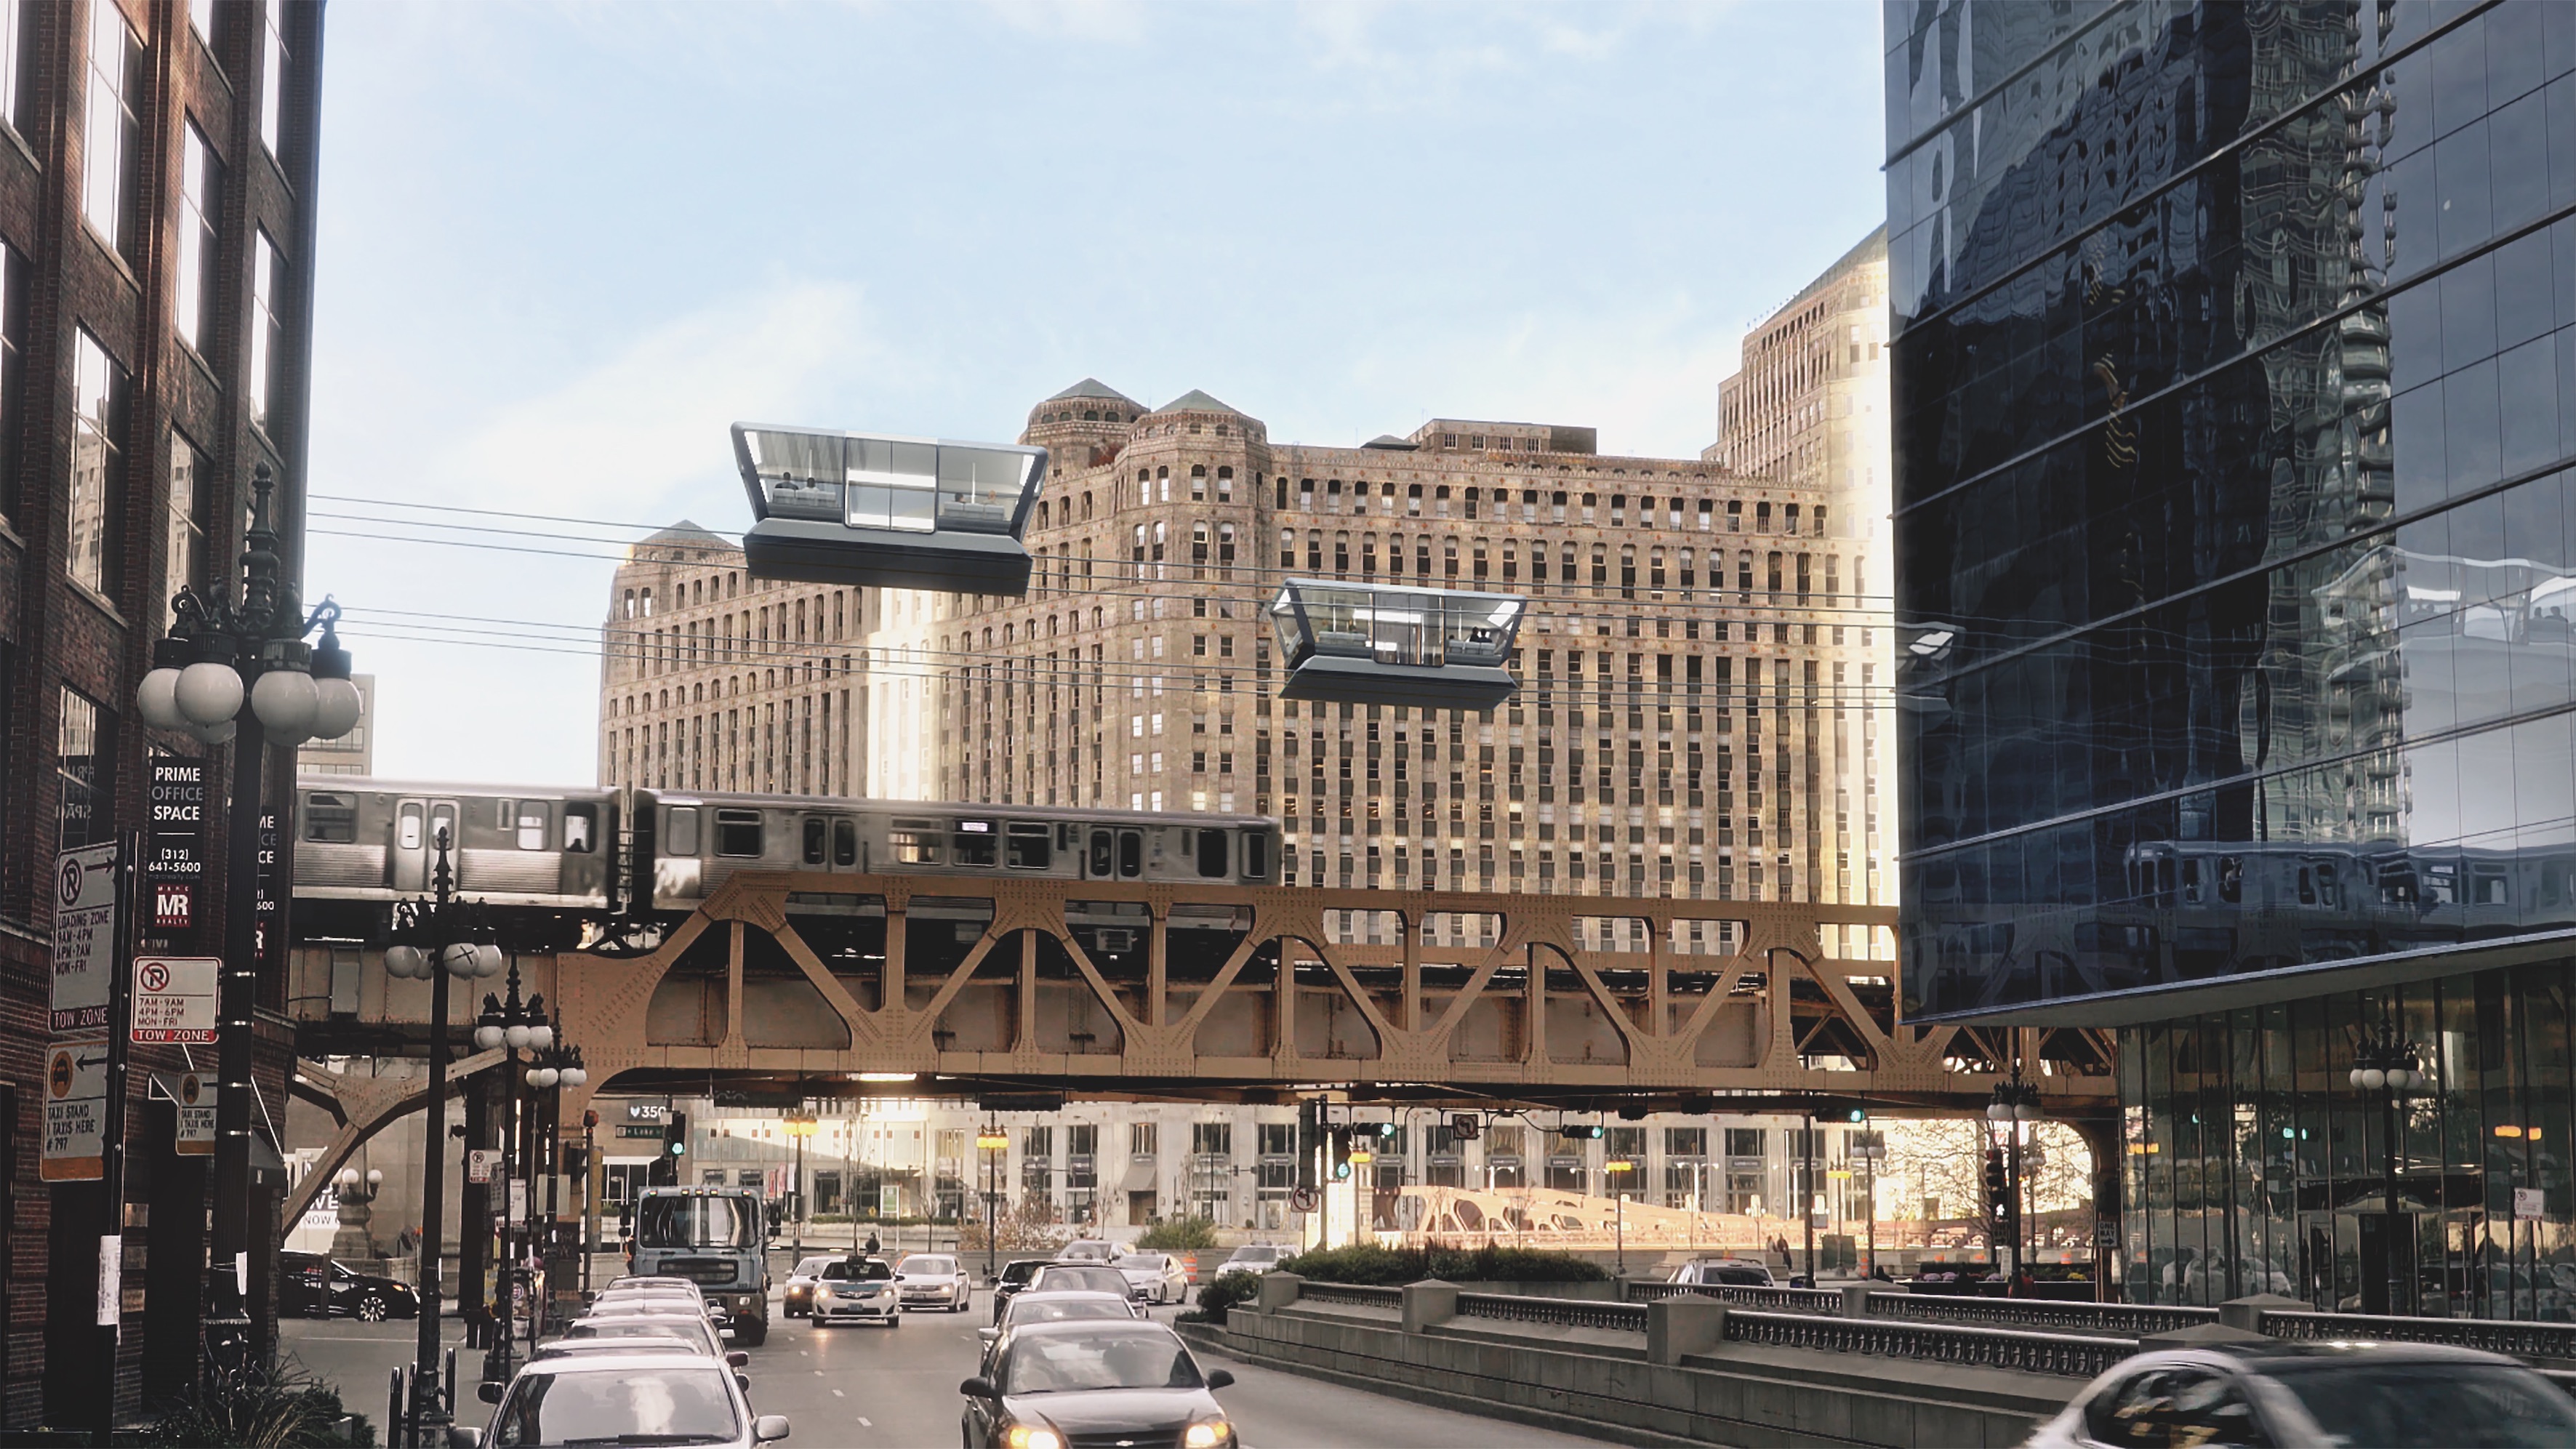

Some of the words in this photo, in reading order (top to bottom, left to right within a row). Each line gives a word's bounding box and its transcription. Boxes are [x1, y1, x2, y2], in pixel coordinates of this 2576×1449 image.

[155, 766, 201, 782] PRIME
[151, 786, 204, 801] OFFICE
[153, 805, 200, 821] SPACE
[161, 848, 189, 861] (312)
[148, 862, 201, 872] 641-5600
[157, 894, 188, 916] MR
[57, 913, 87, 930] LOADING
[90, 910, 109, 926] ZONE
[55, 1011, 74, 1028] TOW
[79, 1007, 108, 1026] ZONE
[137, 1029, 166, 1040] TOW
[173, 1030, 210, 1040] ZONE
[47, 1107, 64, 1121] TAXI
[66, 1104, 89, 1120] STAND
[641, 1105, 667, 1118] 350
[52, 1120, 73, 1136] TAXIS
[76, 1119, 95, 1134] HERE
[305, 1215, 331, 1224] NOW
